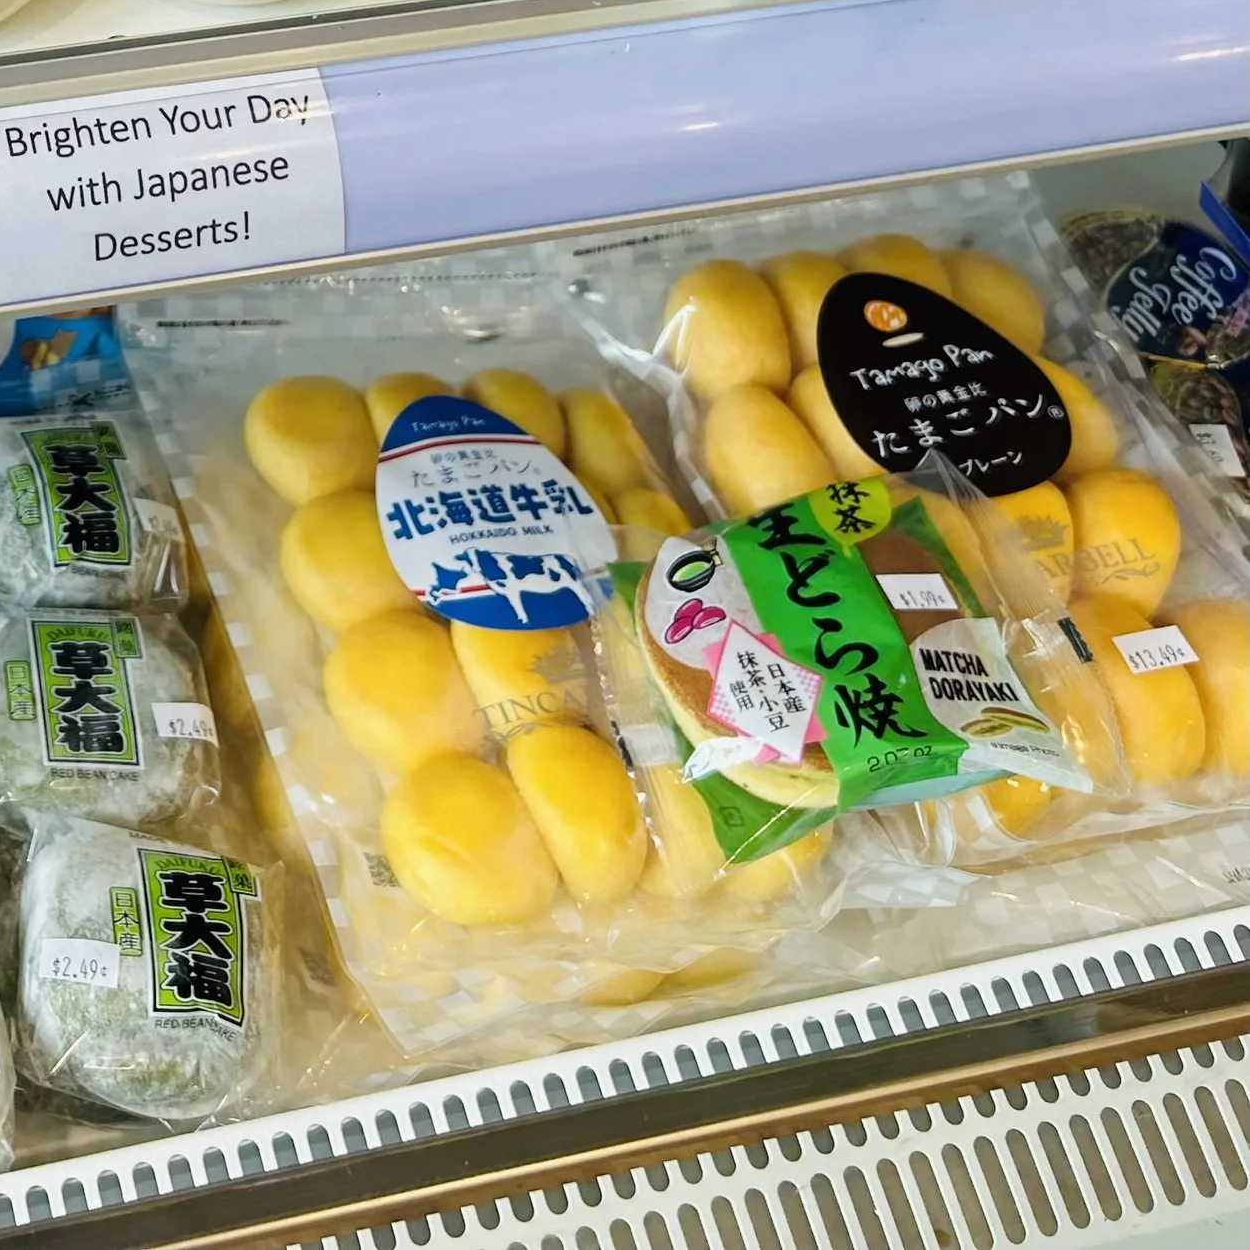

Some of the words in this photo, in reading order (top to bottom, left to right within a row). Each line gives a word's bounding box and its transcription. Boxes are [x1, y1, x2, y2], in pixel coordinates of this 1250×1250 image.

[3, 115, 151, 158] Brighten
[160, 100, 237, 137] Your
[248, 93, 311, 127] Day
[46, 171, 123, 212] with
[133, 155, 291, 208] Japanese
[93, 210, 252, 262] Desserts!
[1111, 267, 1172, 342] Jelly
[1170, 246, 1237, 326] Coffee
[850, 357, 946, 391] Tamago
[943, 344, 996, 367] Pan
[871, 394, 1043, 458] たまごパン
[411, 460, 532, 488] たまごパン
[959, 451, 1022, 477] プレーン
[45, 444, 121, 554] 草大福
[387, 479, 593, 540] 北海道牛乳
[828, 482, 876, 534] 抹茶
[450, 527, 517, 545] HOKKAIDO
[522, 525, 554, 536] MILK
[768, 663, 806, 714] 日本産
[919, 648, 988, 677] MATCHA
[9, 665, 35, 717] 日本産
[50, 641, 123, 752] 草大福
[729, 682, 754, 712] 使用
[930, 676, 1019, 702] DORAYAKI
[51, 768, 75, 779] RED
[77, 769, 104, 780] BEAN
[109, 769, 140, 781] CAKE
[155, 857, 220, 874] DAIFUKU
[114, 892, 141, 950] 日本産
[160, 873, 233, 1006] 草大福
[52, 957, 107, 977] $2.49¢
[155, 1018, 178, 1029] RED
[182, 1018, 212, 1029] BEAN
[213, 1023, 237, 1042] CAKE
